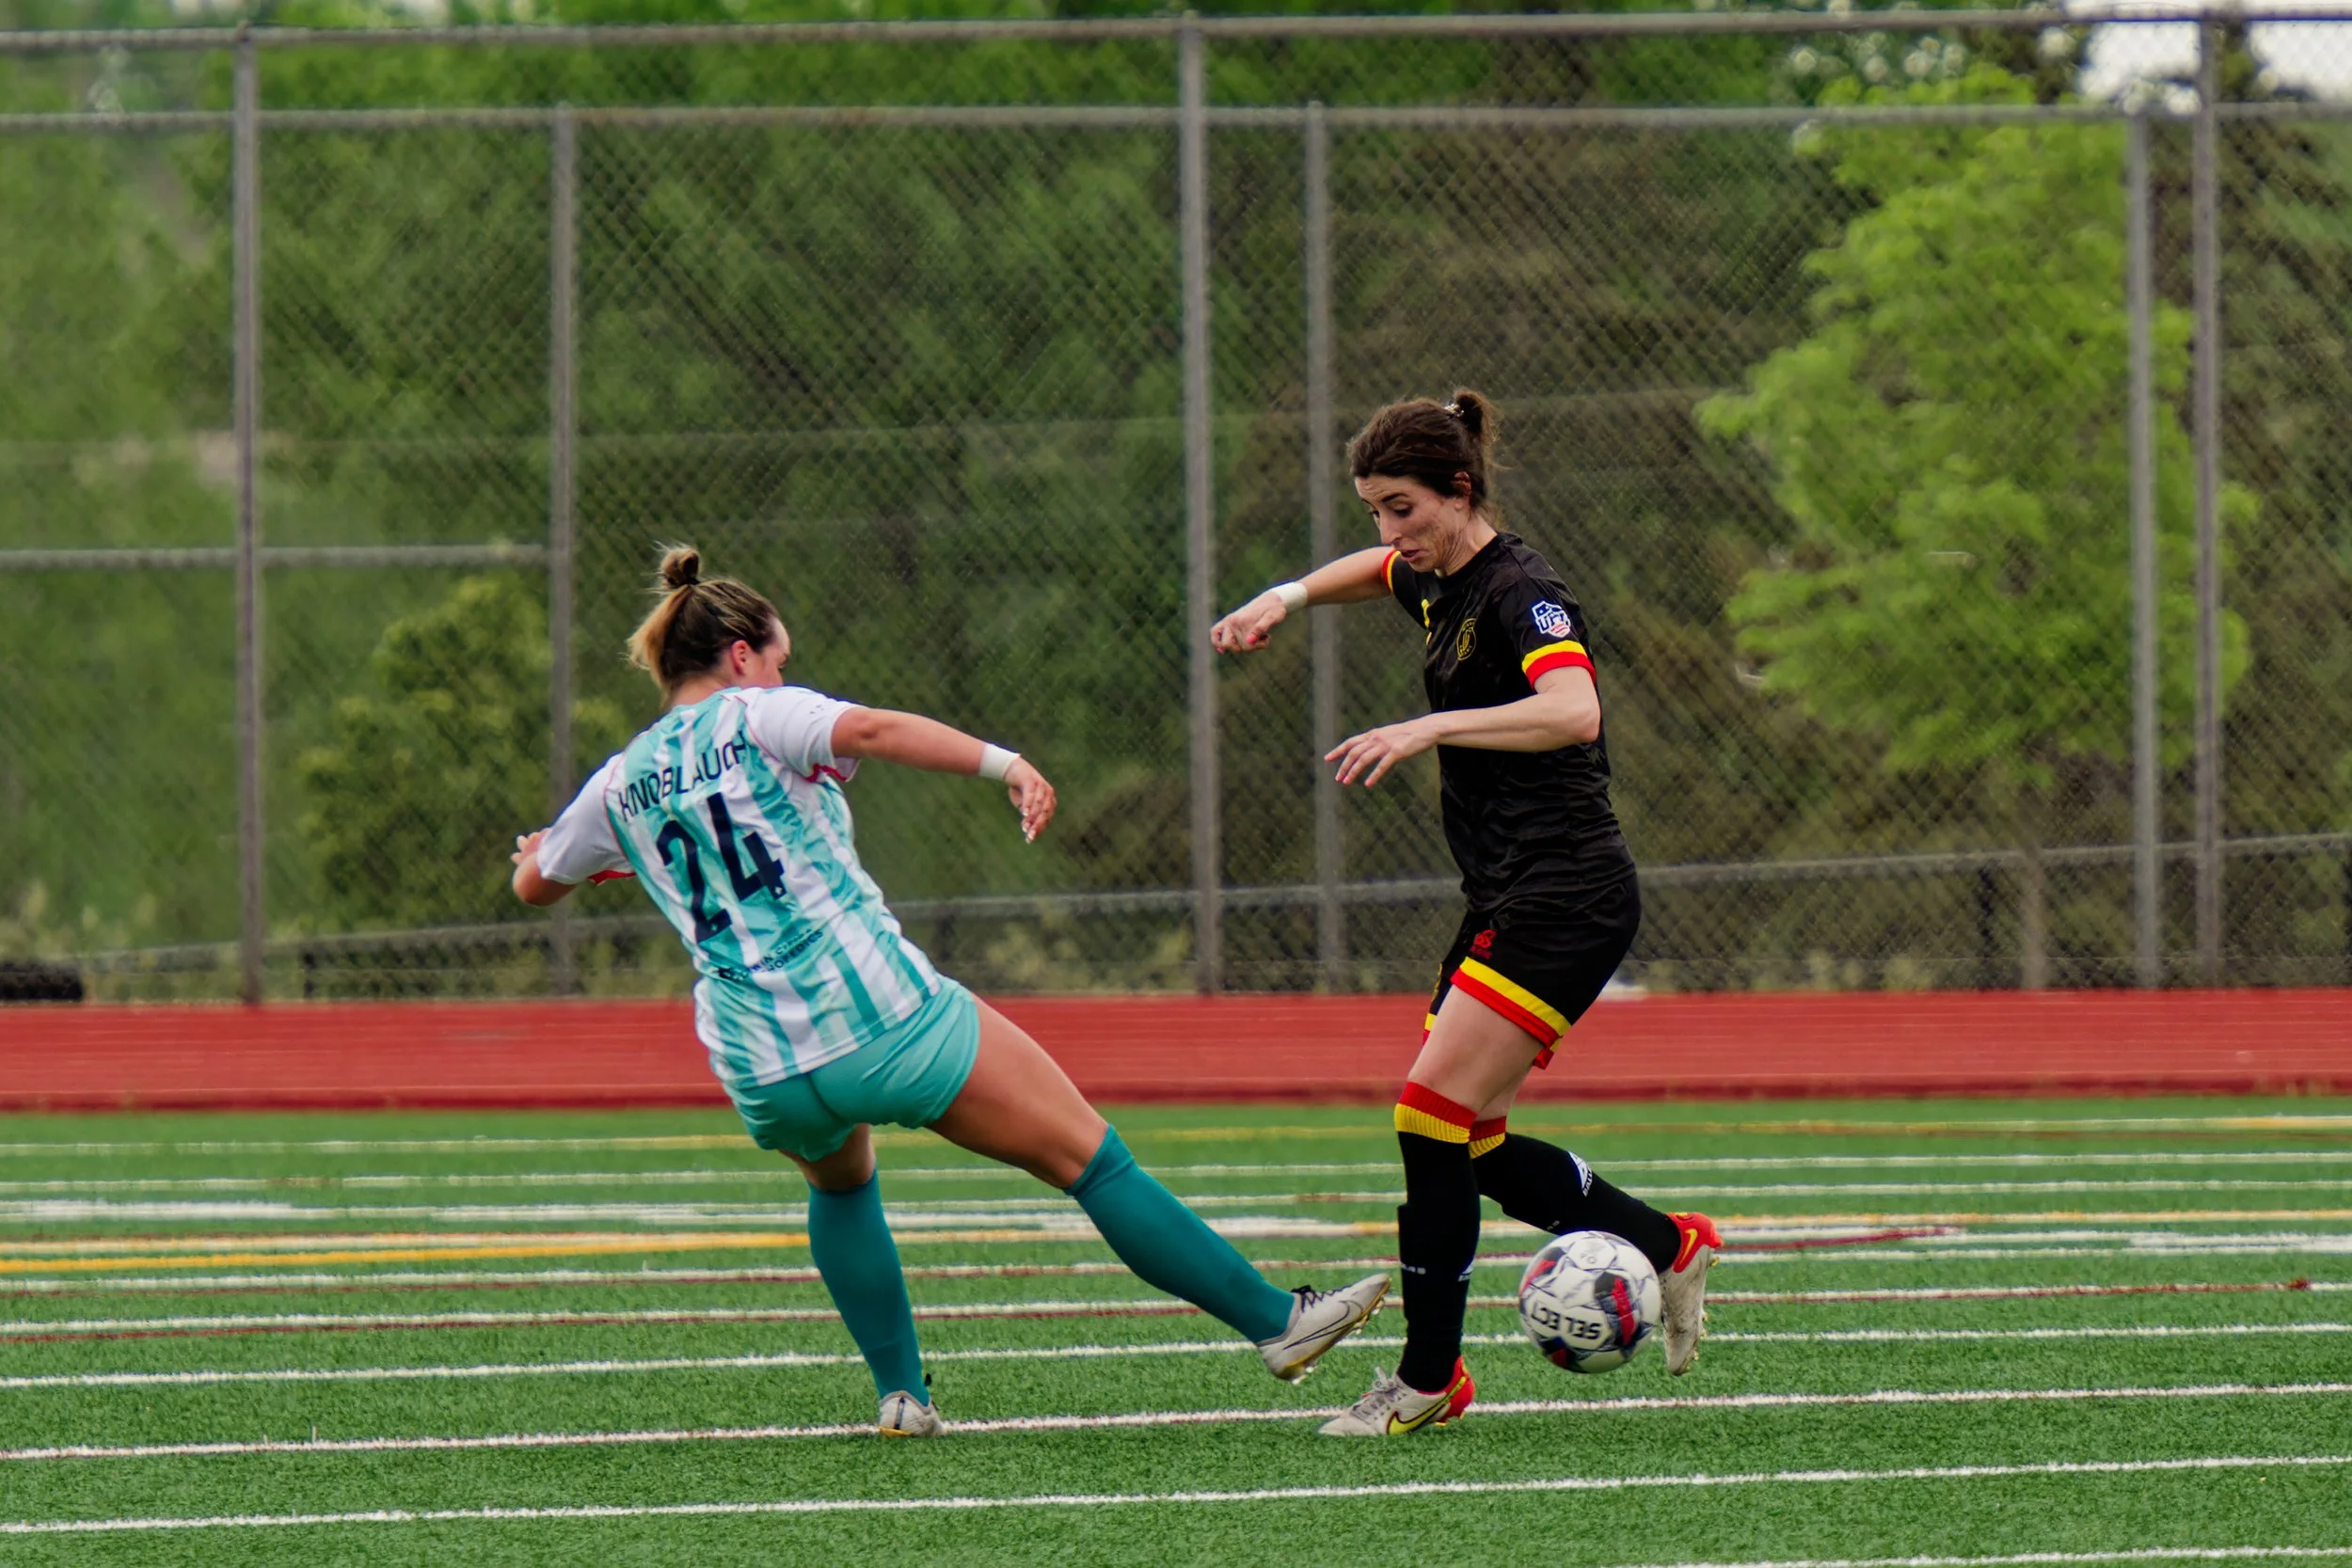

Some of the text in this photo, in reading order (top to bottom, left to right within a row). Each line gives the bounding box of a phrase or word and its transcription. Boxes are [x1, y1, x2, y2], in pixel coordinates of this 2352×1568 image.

[618, 730, 745, 822] KNOBLAUCH
[656, 791, 787, 943] 24
[1531, 1302, 1601, 1340] SELECT
